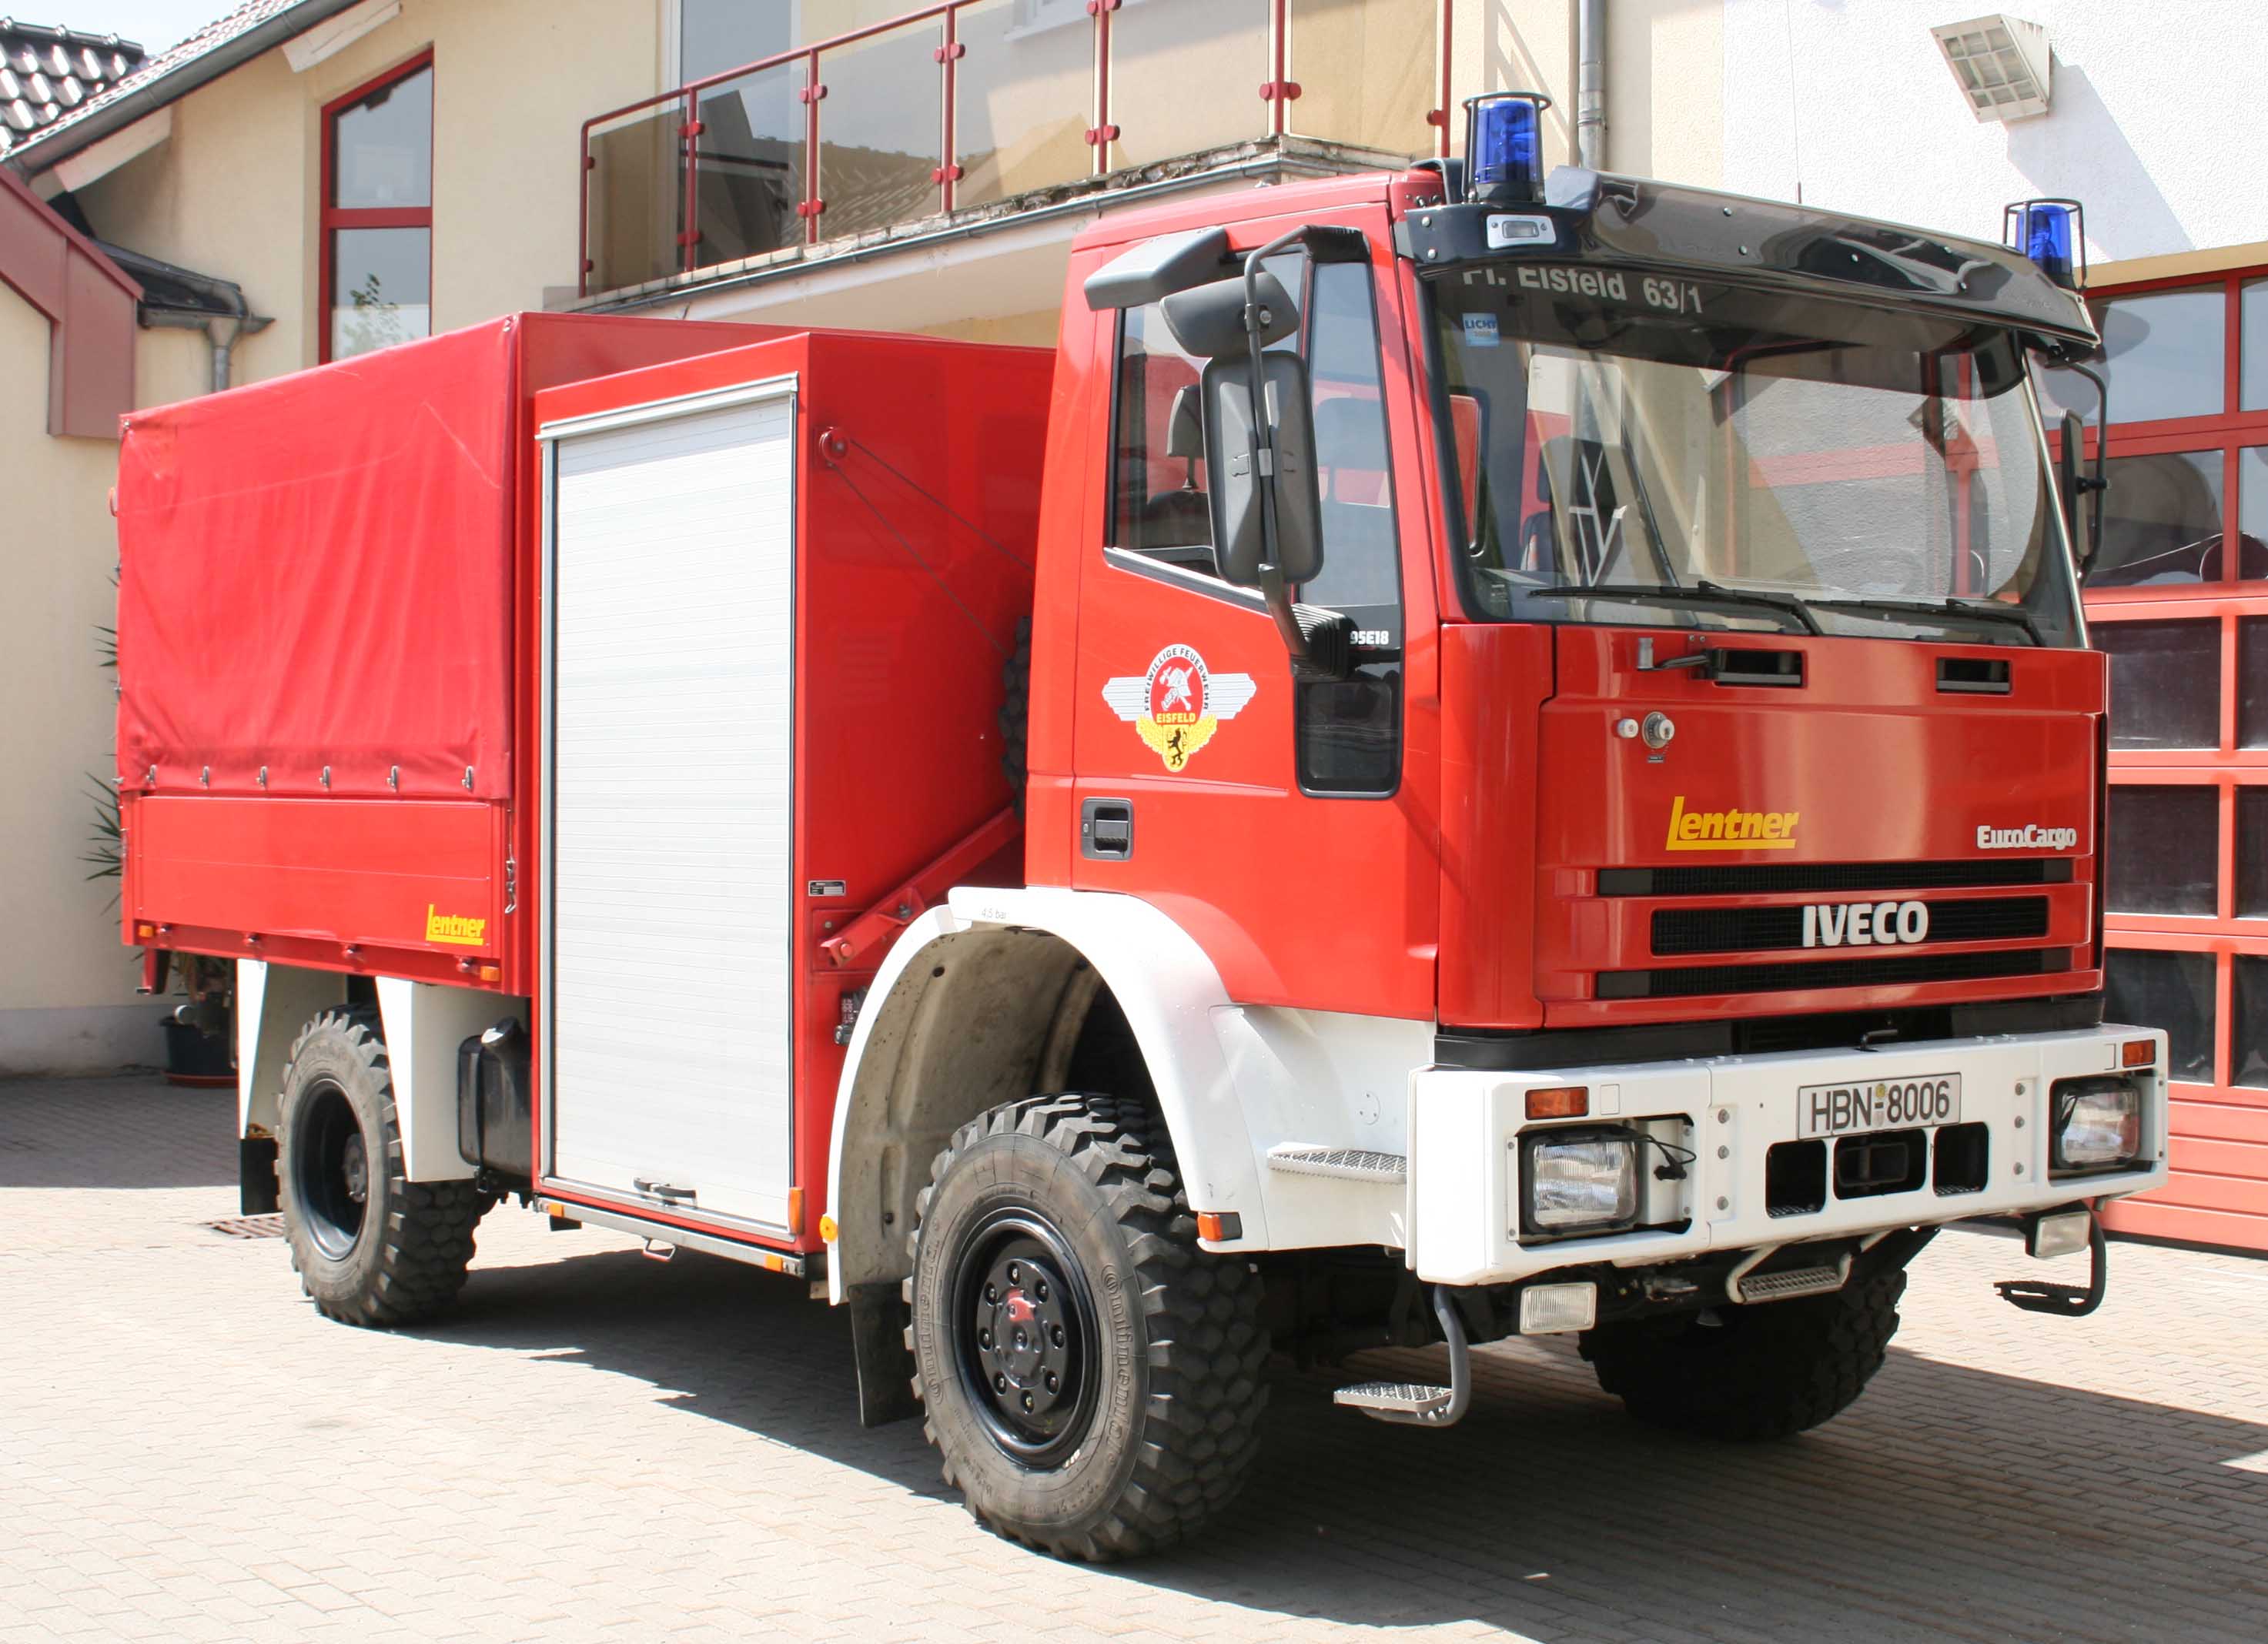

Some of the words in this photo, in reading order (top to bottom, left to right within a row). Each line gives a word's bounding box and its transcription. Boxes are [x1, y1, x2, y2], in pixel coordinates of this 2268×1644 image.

[1642, 276, 1703, 314] 63/1
[1145, 647, 1177, 711] FREIWILLIGE
[1179, 647, 1209, 710] FEUERWEHR
[1156, 713, 1196, 723] EISFELD
[1976, 824, 2077, 850] EuroCargo
[1802, 901, 1929, 948] IVECO
